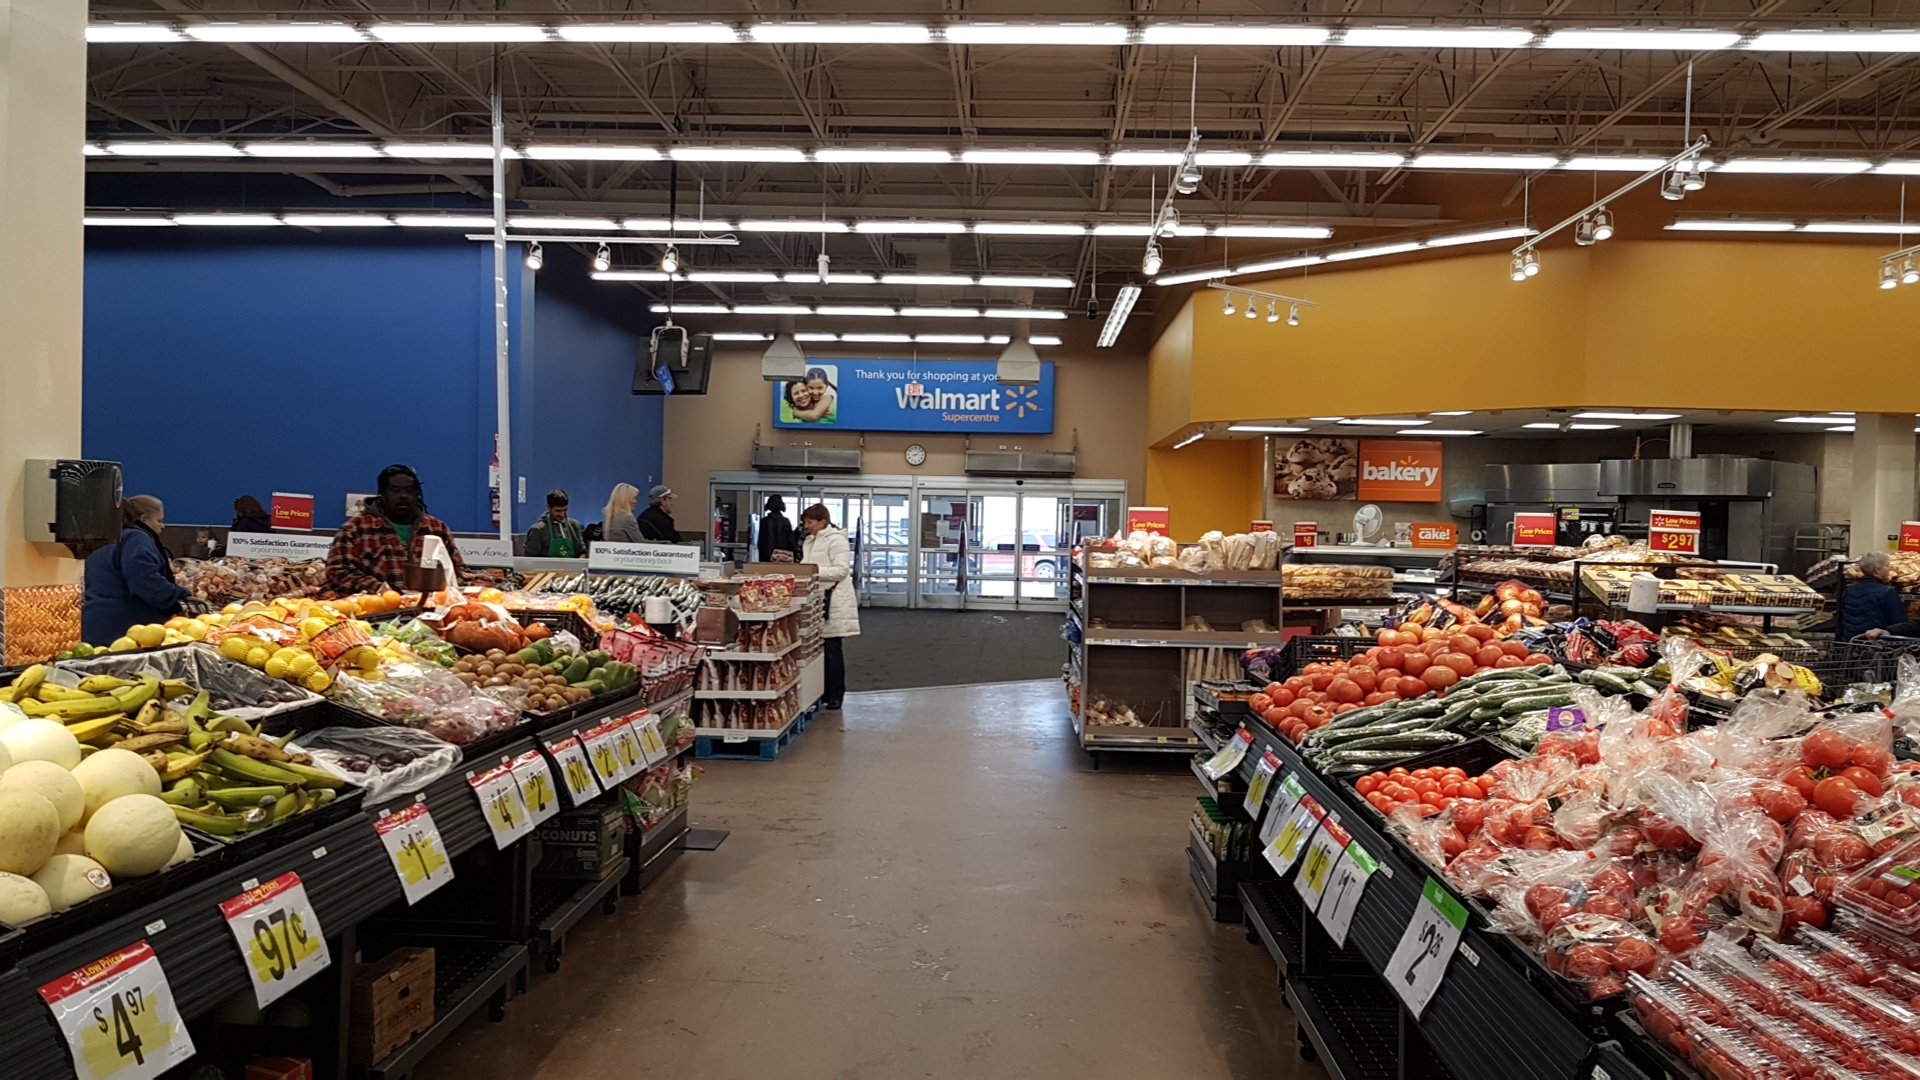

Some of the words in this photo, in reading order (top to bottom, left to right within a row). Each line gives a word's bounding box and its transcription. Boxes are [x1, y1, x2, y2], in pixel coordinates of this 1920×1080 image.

[855, 369, 885, 379] Thank
[886, 372, 905, 381] you
[907, 370, 920, 379] for
[923, 370, 968, 382] shopping
[971, 373, 981, 381] at
[908, 384, 922, 395] EXIT
[895, 387, 1000, 411] Walmart
[942, 412, 1000, 423] Supercentre
[1363, 460, 1439, 487] bakery
[275, 508, 289, 516] Low
[290, 510, 310, 518] Prices
[1147, 521, 1166, 529] Prices
[1418, 527, 1450, 540] cake!
[250, 538, 288, 547] Satisfaction
[290, 540, 332, 549] Guaranteed
[482, 546, 509, 557] home
[594, 547, 611, 555] 100%
[612, 548, 652, 557] Satisfaction
[653, 550, 693, 559] Guaranteed
[533, 830, 597, 842] OCONUTS
[261, 880, 280, 894] Prices
[82, 963, 101, 977] Low
[99, 953, 125, 970] Prices
